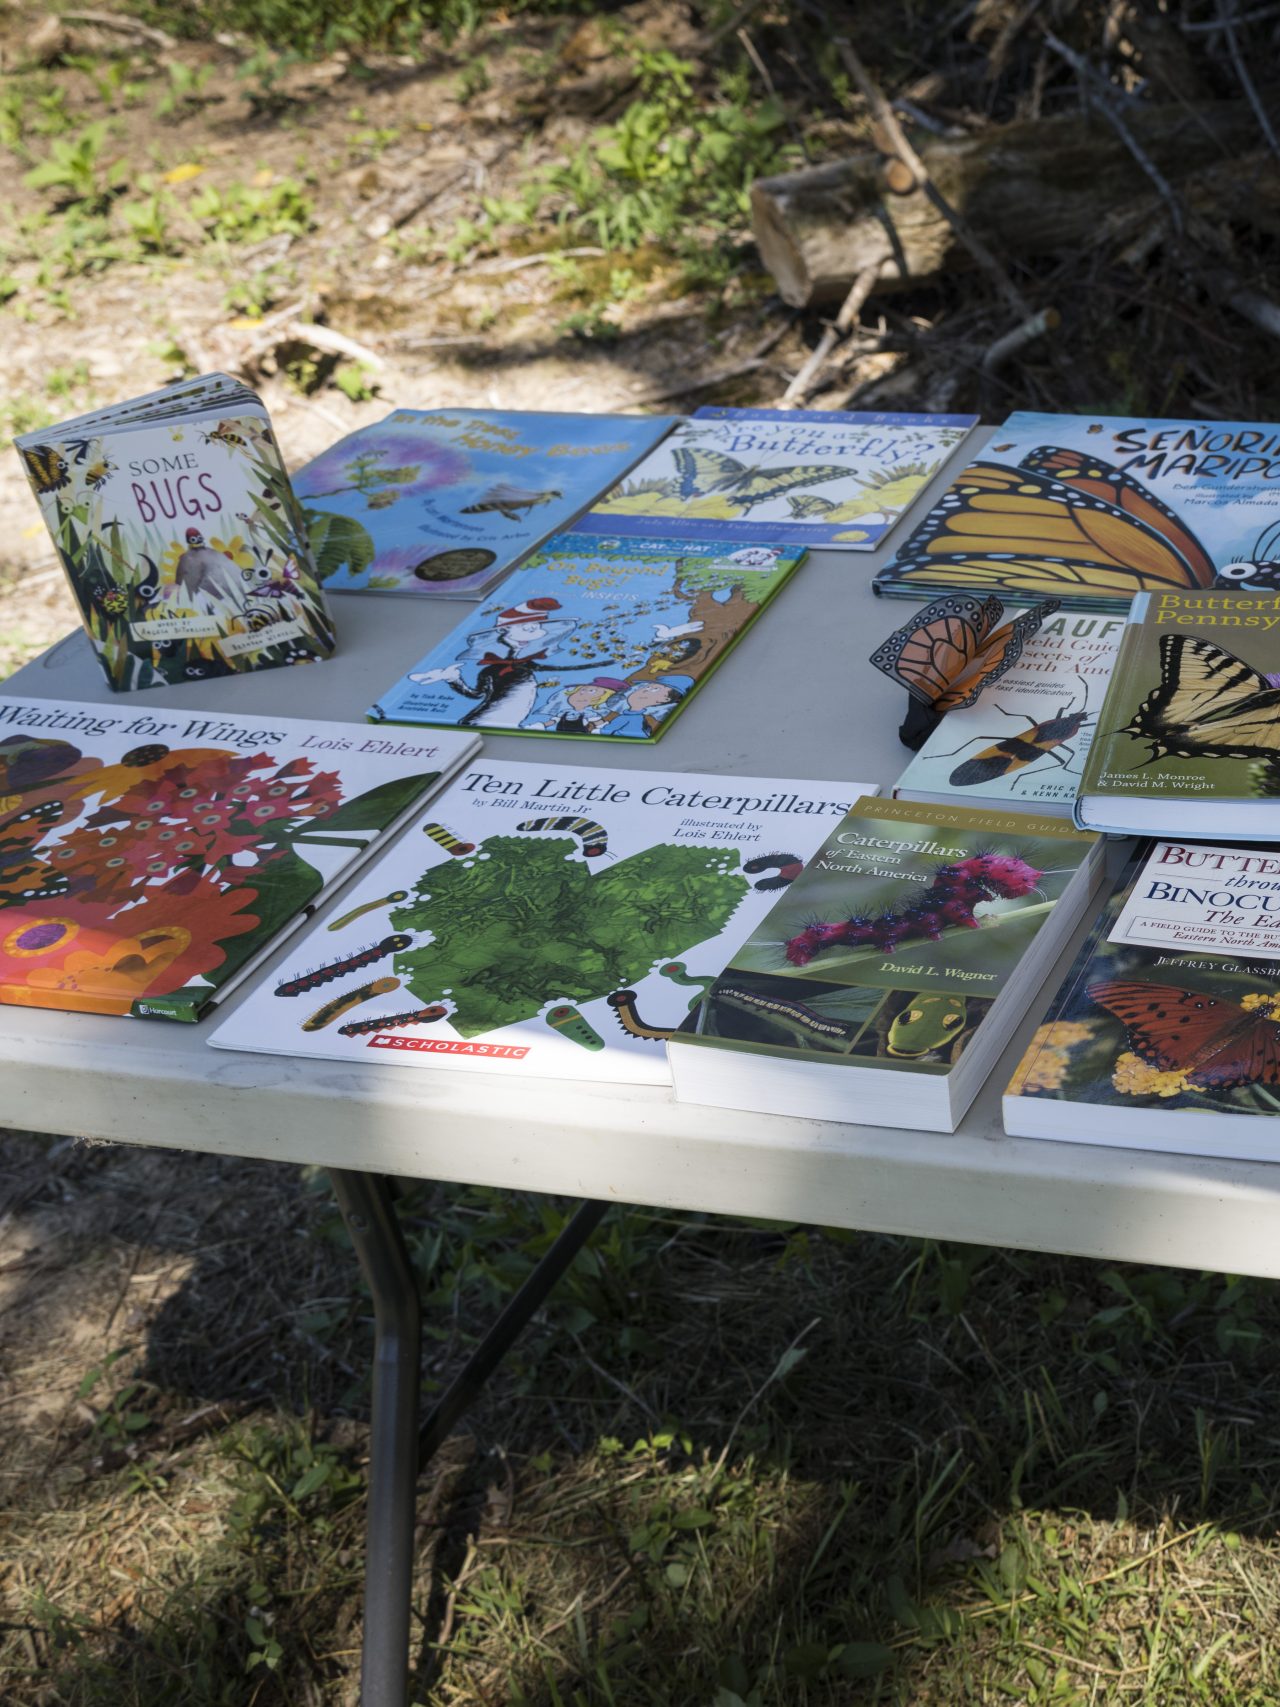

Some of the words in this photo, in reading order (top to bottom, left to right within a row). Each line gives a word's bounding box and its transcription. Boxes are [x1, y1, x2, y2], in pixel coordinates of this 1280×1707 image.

[714, 424, 764, 435] Are
[767, 424, 825, 439] you
[833, 431, 847, 440] a
[726, 434, 935, 465] Butterfly?
[128, 453, 199, 477] SOME
[131, 473, 222, 523] BUGS
[1184, 498, 1230, 506] Marcos
[1232, 498, 1279, 506] Almada
[638, 542, 666, 550] CAT
[547, 561, 577, 572] On
[585, 562, 671, 577] Beyond
[562, 574, 633, 590] Bugs!
[1022, 651, 1072, 662] sects
[1077, 650, 1109, 665] of
[1012, 661, 1057, 674] orth
[1003, 678, 1034, 687] easiest
[1035, 680, 1065, 690] guides
[1015, 686, 1074, 698] identification
[0, 705, 122, 738] Waiting
[119, 715, 180, 737] for
[181, 719, 289, 747] Wings
[299, 734, 354, 752] Lois
[358, 739, 443, 760] Ehlert
[1099, 771, 1139, 781] James
[1141, 772, 1154, 781] L.
[1157, 773, 1206, 782] Monroe
[1097, 779, 1109, 788] &
[1112, 780, 1149, 789] David
[1151, 781, 1169, 789] M.
[1171, 781, 1216, 791] Wright
[460, 773, 524, 797] Ten
[530, 777, 631, 804] Little
[641, 786, 852, 817] Caterpillars
[1032, 790, 1060, 798] KENN
[472, 797, 489, 809] by
[491, 797, 518, 809] Bill
[520, 800, 572, 814] Martin
[573, 802, 593, 815] Jr
[679, 817, 743, 832] illustrated
[744, 820, 764, 832] by
[863, 804, 960, 823] PRINCETON
[967, 816, 1017, 829] FIELD
[673, 827, 707, 839] Lois
[709, 829, 763, 843] Ehlert
[836, 831, 969, 859] Caterpillars
[824, 847, 845, 859] of
[846, 848, 902, 866] Eastern
[814, 859, 869, 877] North
[869, 866, 929, 883] America
[1204, 908, 1251, 928] The
[1152, 921, 1182, 932] FIELD
[1183, 925, 1218, 936] GUIDE
[1219, 929, 1237, 937] TO
[1239, 930, 1264, 939] THE
[1173, 930, 1217, 944] Eastern
[1219, 934, 1254, 947] North
[1154, 955, 1219, 971] JEFFREY
[879, 961, 927, 976] David
[928, 966, 941, 976] L.
[942, 967, 999, 984] Wagner
[392, 1039, 526, 1058] SCHOLASTIC
